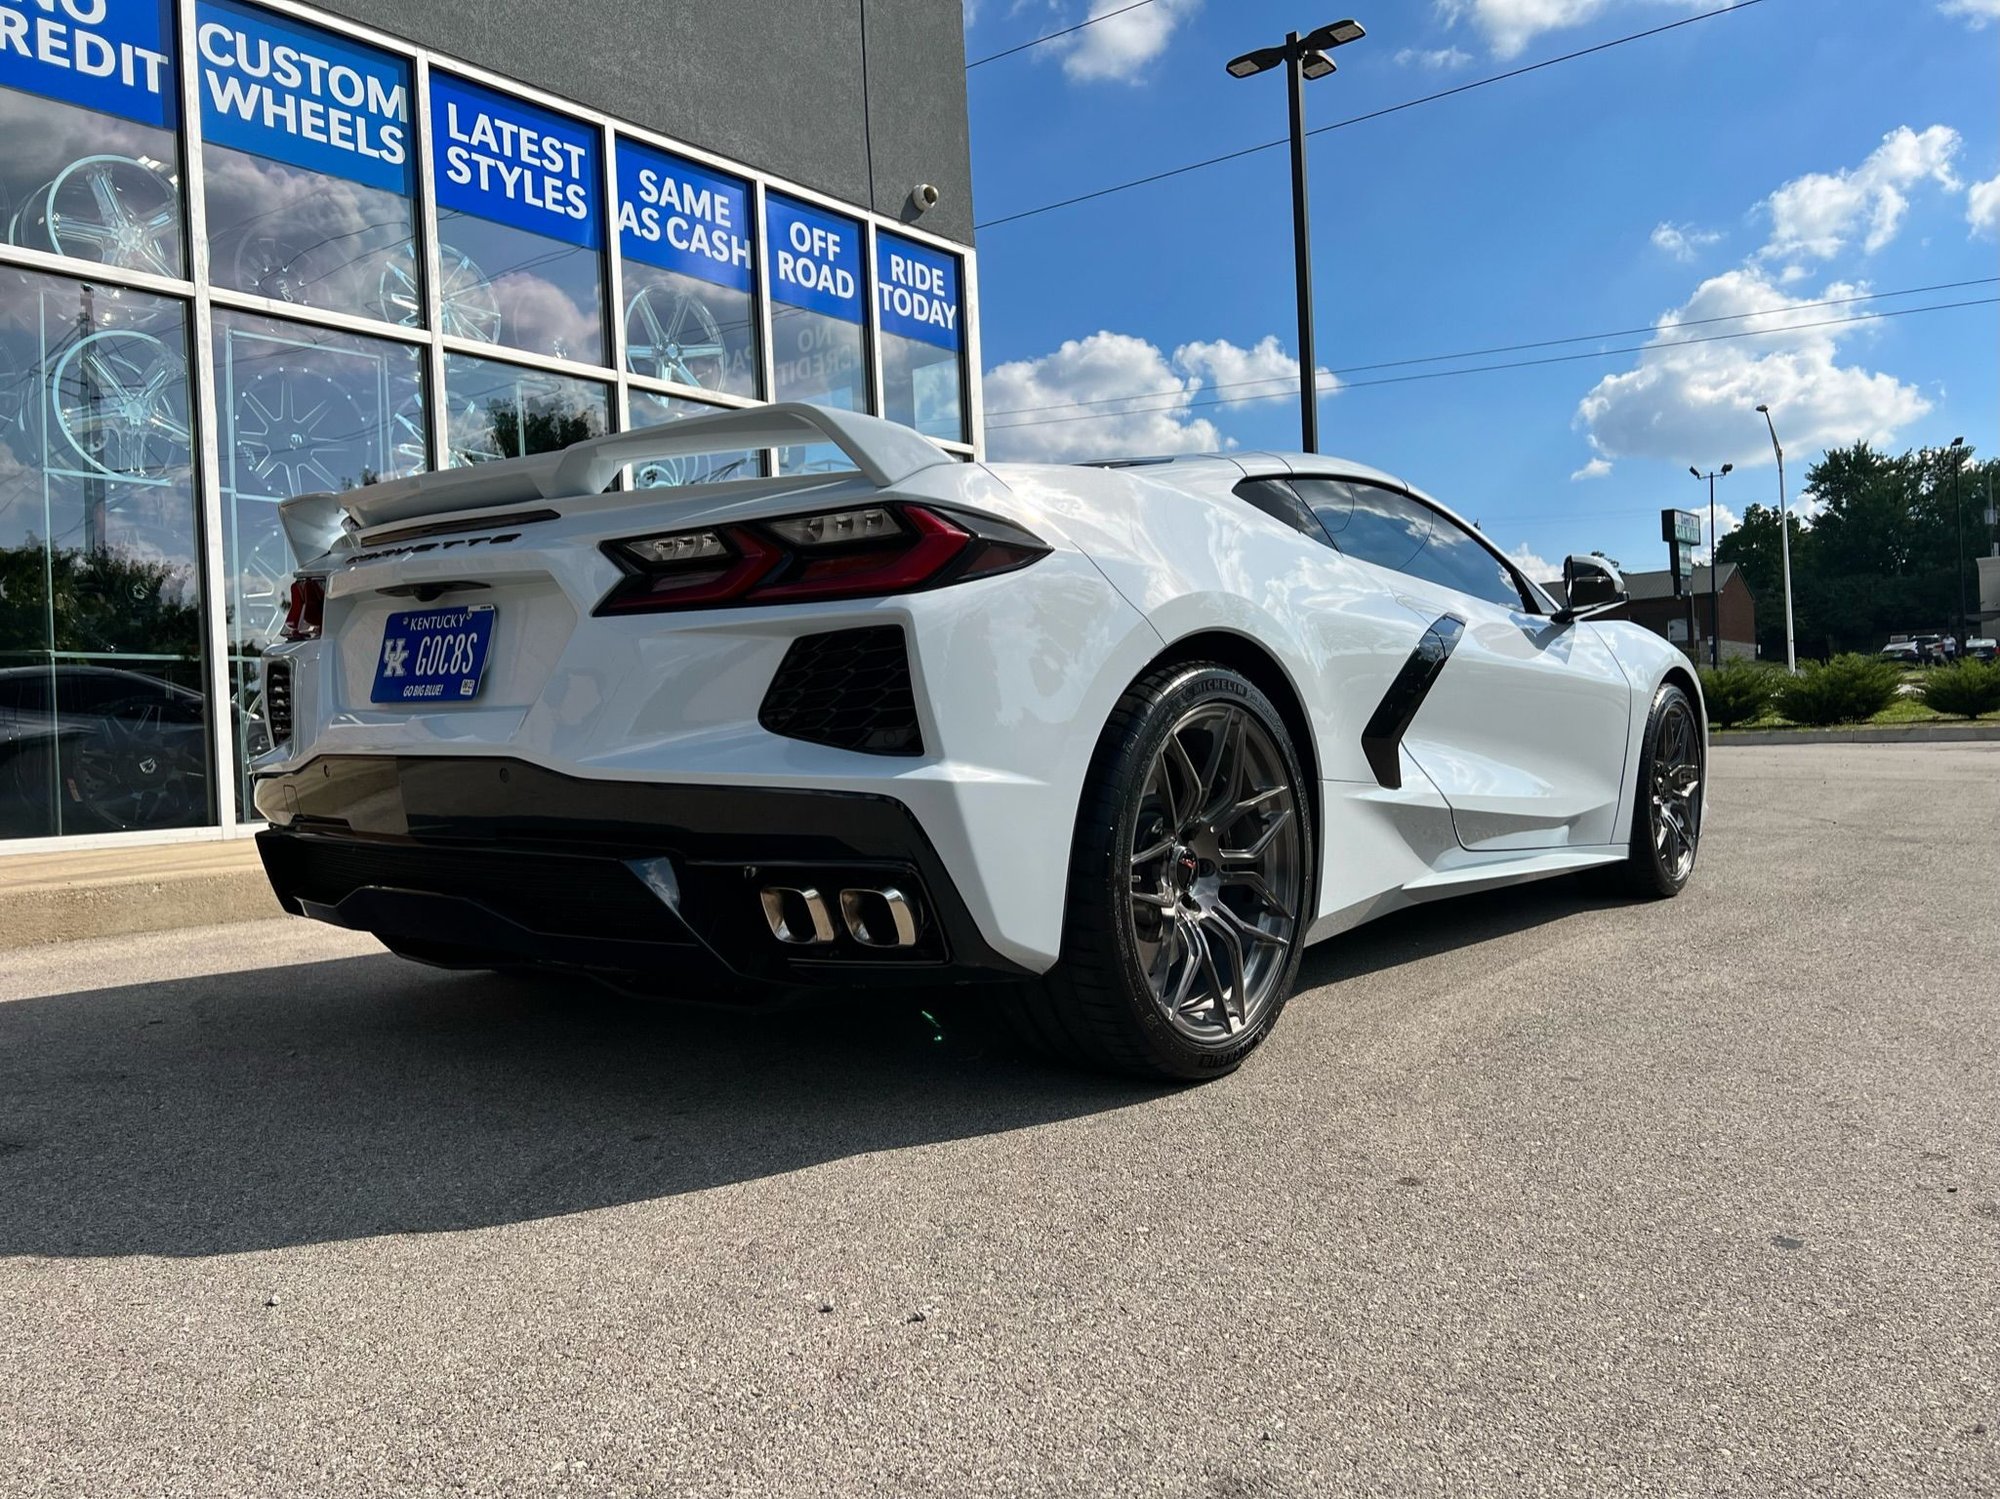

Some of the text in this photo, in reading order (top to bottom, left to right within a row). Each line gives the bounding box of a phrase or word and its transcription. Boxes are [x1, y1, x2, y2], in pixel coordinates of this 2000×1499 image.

[10, 0, 107, 25] O
[198, 22, 408, 123] CUSTOM
[205, 69, 406, 165] WHEELS
[447, 102, 586, 179] LATEST
[446, 146, 588, 220] STYLES
[638, 169, 732, 230] SAME
[618, 199, 752, 271] AS CASH
[789, 221, 841, 262] OFF
[777, 249, 855, 300] ROAD
[890, 254, 946, 297] RIDE
[878, 281, 957, 331] TODAY
[410, 614, 467, 631] KENTUCKY
[403, 684, 444, 697] GO BIG BLUE!
[1194, 678, 1246, 696] MICHELIN
